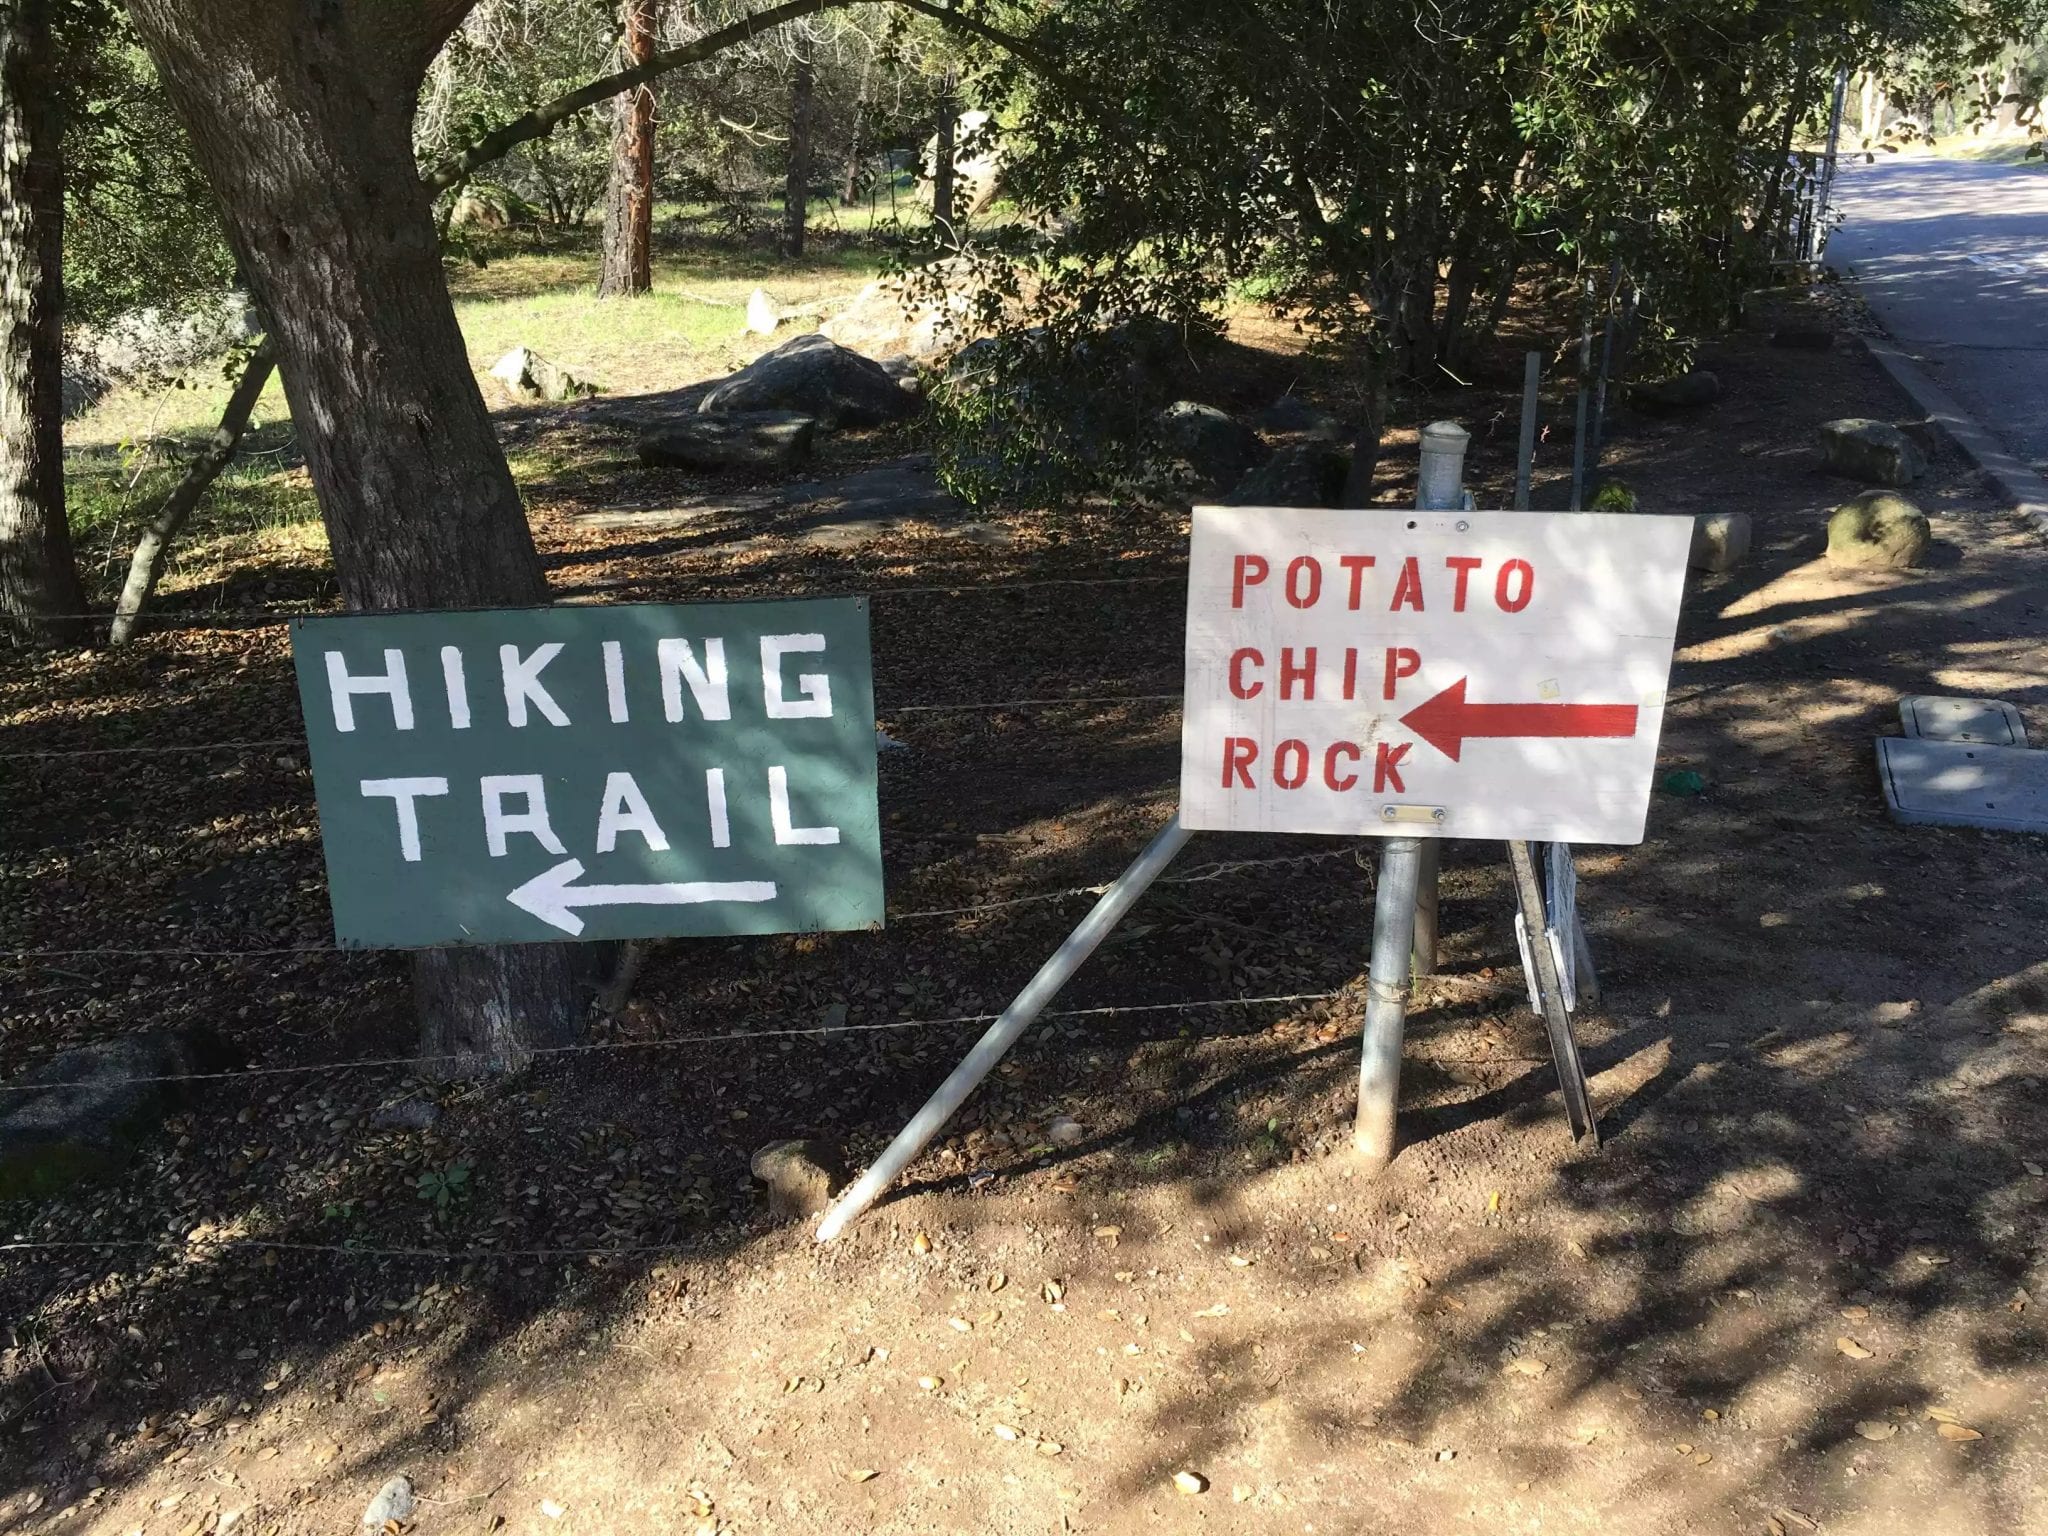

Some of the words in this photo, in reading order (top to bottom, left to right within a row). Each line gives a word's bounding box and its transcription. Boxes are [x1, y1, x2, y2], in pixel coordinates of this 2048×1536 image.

[1231, 554, 1536, 613] POTATO
[324, 633, 834, 732] HIKING
[1228, 646, 1422, 701] CHIP
[1221, 736, 1414, 794] ROCK
[360, 765, 841, 862] TRAIL
